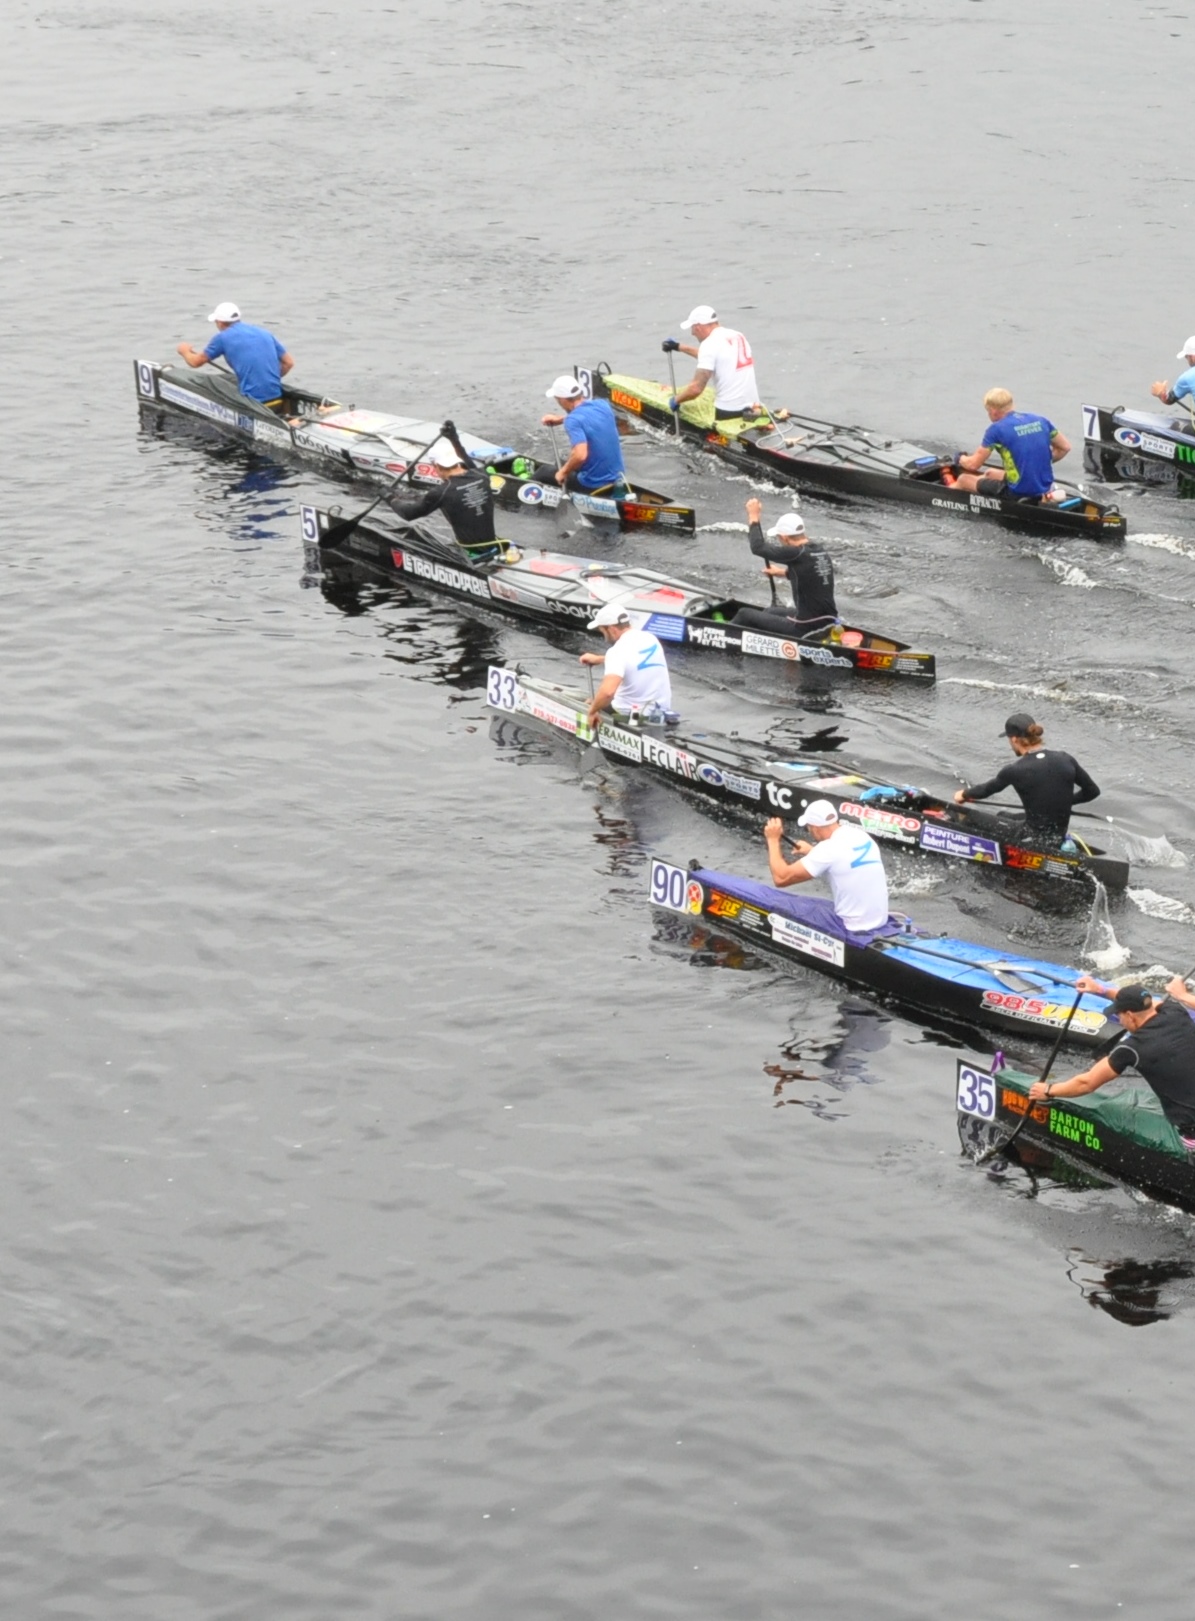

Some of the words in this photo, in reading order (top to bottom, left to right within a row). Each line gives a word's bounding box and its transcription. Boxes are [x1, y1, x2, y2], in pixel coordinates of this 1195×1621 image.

[139, 364, 153, 394] 9
[579, 370, 591, 398] 3
[1083, 407, 1097, 437] 7
[302, 506, 317, 540] 5
[800, 646, 832, 658] sports
[813, 656, 852, 668] experts
[488, 669, 515, 710] 33
[642, 738, 699, 782] LECLAIR
[924, 826, 971, 844] PEINTURE
[652, 863, 686, 909] 90
[1054, 1019, 1088, 1033] STTION
[959, 1068, 994, 1118] 35
[1049, 1120, 1080, 1143] FARM
[1050, 1107, 1094, 1136] BARTON
